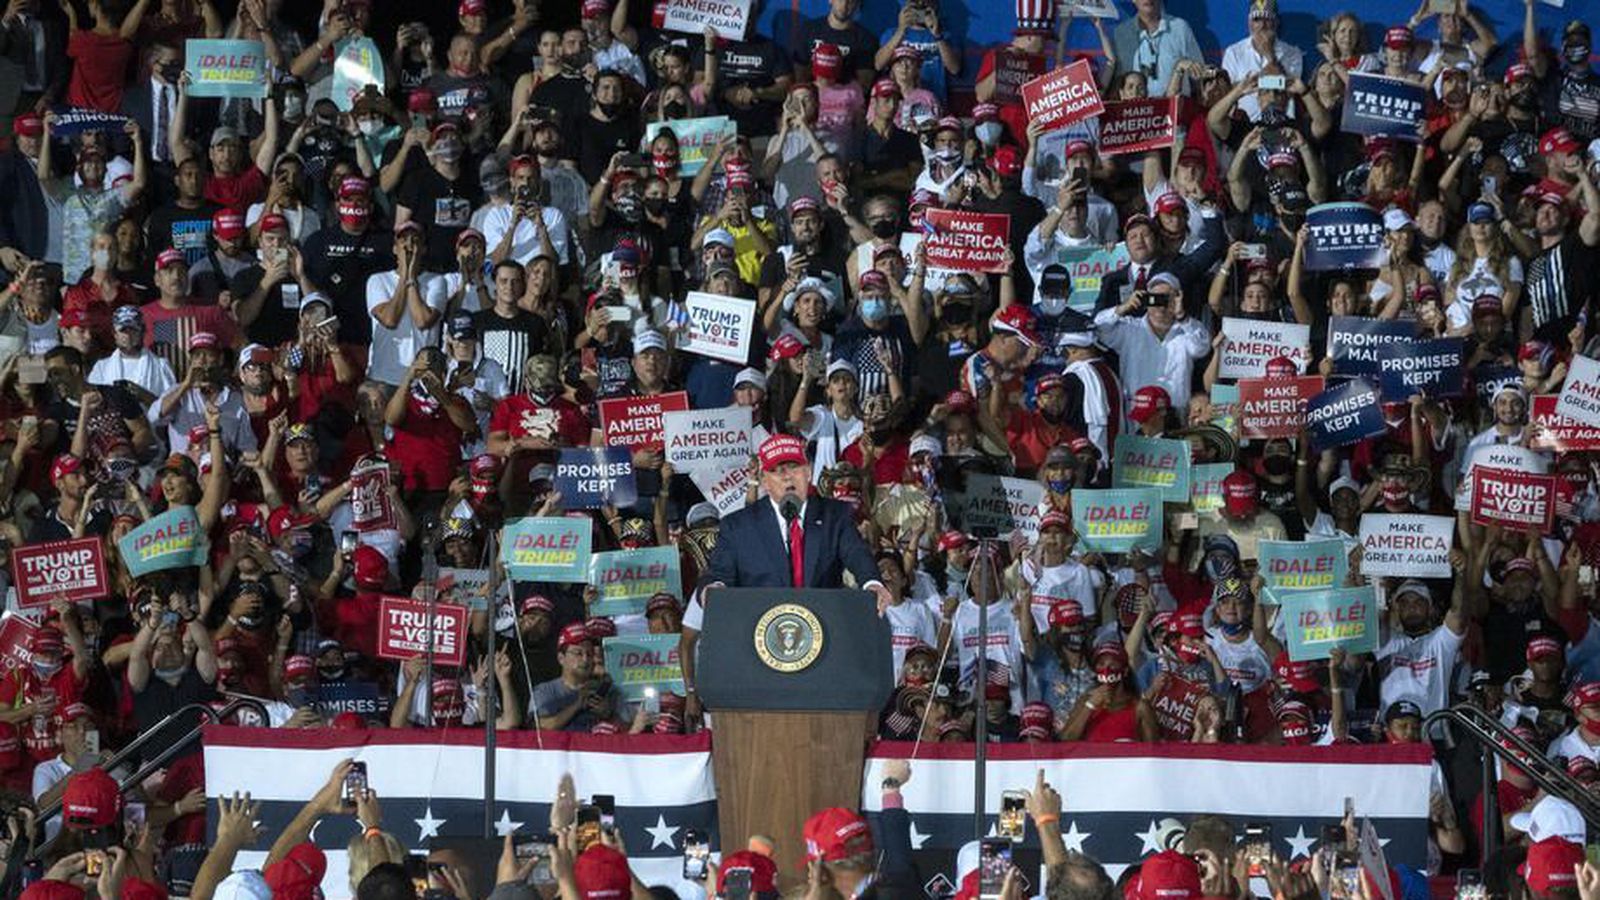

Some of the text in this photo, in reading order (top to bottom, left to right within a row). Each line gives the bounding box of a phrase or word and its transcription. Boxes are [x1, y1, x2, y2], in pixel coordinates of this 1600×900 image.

[667, 0, 743, 19] AMERICA
[671, 9, 742, 31] GREAT AGAIN
[725, 51, 764, 68] Trump
[200, 69, 256, 83] TRUMP
[1042, 75, 1070, 94] MAKE
[1030, 80, 1093, 116] AMERICA
[1353, 90, 1422, 111] TRUMP
[1037, 94, 1099, 125] REAT AGAIN
[1122, 106, 1154, 117] MAKE
[1357, 103, 1415, 119] PENCE
[1103, 114, 1173, 135] AMERICA
[1103, 127, 1173, 146] GREAT AGAIN
[950, 220, 985, 232] MAKE
[1310, 223, 1383, 238] TRUMP
[926, 231, 1004, 249] AMERICA
[1318, 235, 1377, 245] PENCE
[926, 246, 1005, 261] GREAT AGAIN
[692, 306, 741, 326] TRUMP
[701, 322, 740, 341] VOTE
[1249, 330, 1282, 341] MAKE
[1225, 341, 1303, 360] AMERICA
[1224, 355, 1262, 368] GREAT
[1381, 353, 1460, 373] PROMISES
[1402, 370, 1442, 386] KEPT
[1263, 385, 1298, 398] MAKE
[628, 403, 662, 416] MAKE
[1243, 398, 1308, 415] AMERI
[1307, 391, 1376, 424] PROMISES
[608, 415, 667, 434] AMERI
[692, 419, 726, 430] MAKE
[1242, 415, 1281, 428] GREAT
[1324, 411, 1361, 433] KEPT
[608, 433, 648, 447] GREAT
[671, 430, 748, 449] AMERICA
[1575, 428, 1600, 440] AGA
[671, 446, 750, 462] GREAT AGAIN
[1489, 453, 1524, 466] MAKE
[557, 462, 632, 478] PROMISES
[577, 478, 617, 493] KEPT
[991, 486, 1023, 499] MAKE
[1481, 478, 1546, 500] TRUMP
[353, 499, 382, 515] OTE
[969, 498, 1040, 517] AMERICA
[1084, 501, 1151, 522] ¡DALÉ!
[1495, 494, 1546, 515] VOTE
[1086, 521, 1148, 535] TRUMP
[1388, 522, 1425, 533] MAKE
[514, 528, 580, 549] ¡DALÉ!
[1364, 534, 1448, 551] AMERICA
[22, 549, 93, 573] TRUMP
[514, 549, 576, 565] TRUMP
[1268, 553, 1335, 574] ¡DALÉ!
[1364, 552, 1448, 565] GREAT AGAIN
[42, 563, 96, 585] VOTE
[601, 560, 668, 583] ¡DALÉ!
[1274, 573, 1335, 587] TRUMP
[604, 581, 666, 598] TRUMP
[388, 609, 456, 631] TRUMP
[403, 626, 456, 647] VOTE
[1303, 622, 1366, 641] TRUMP
